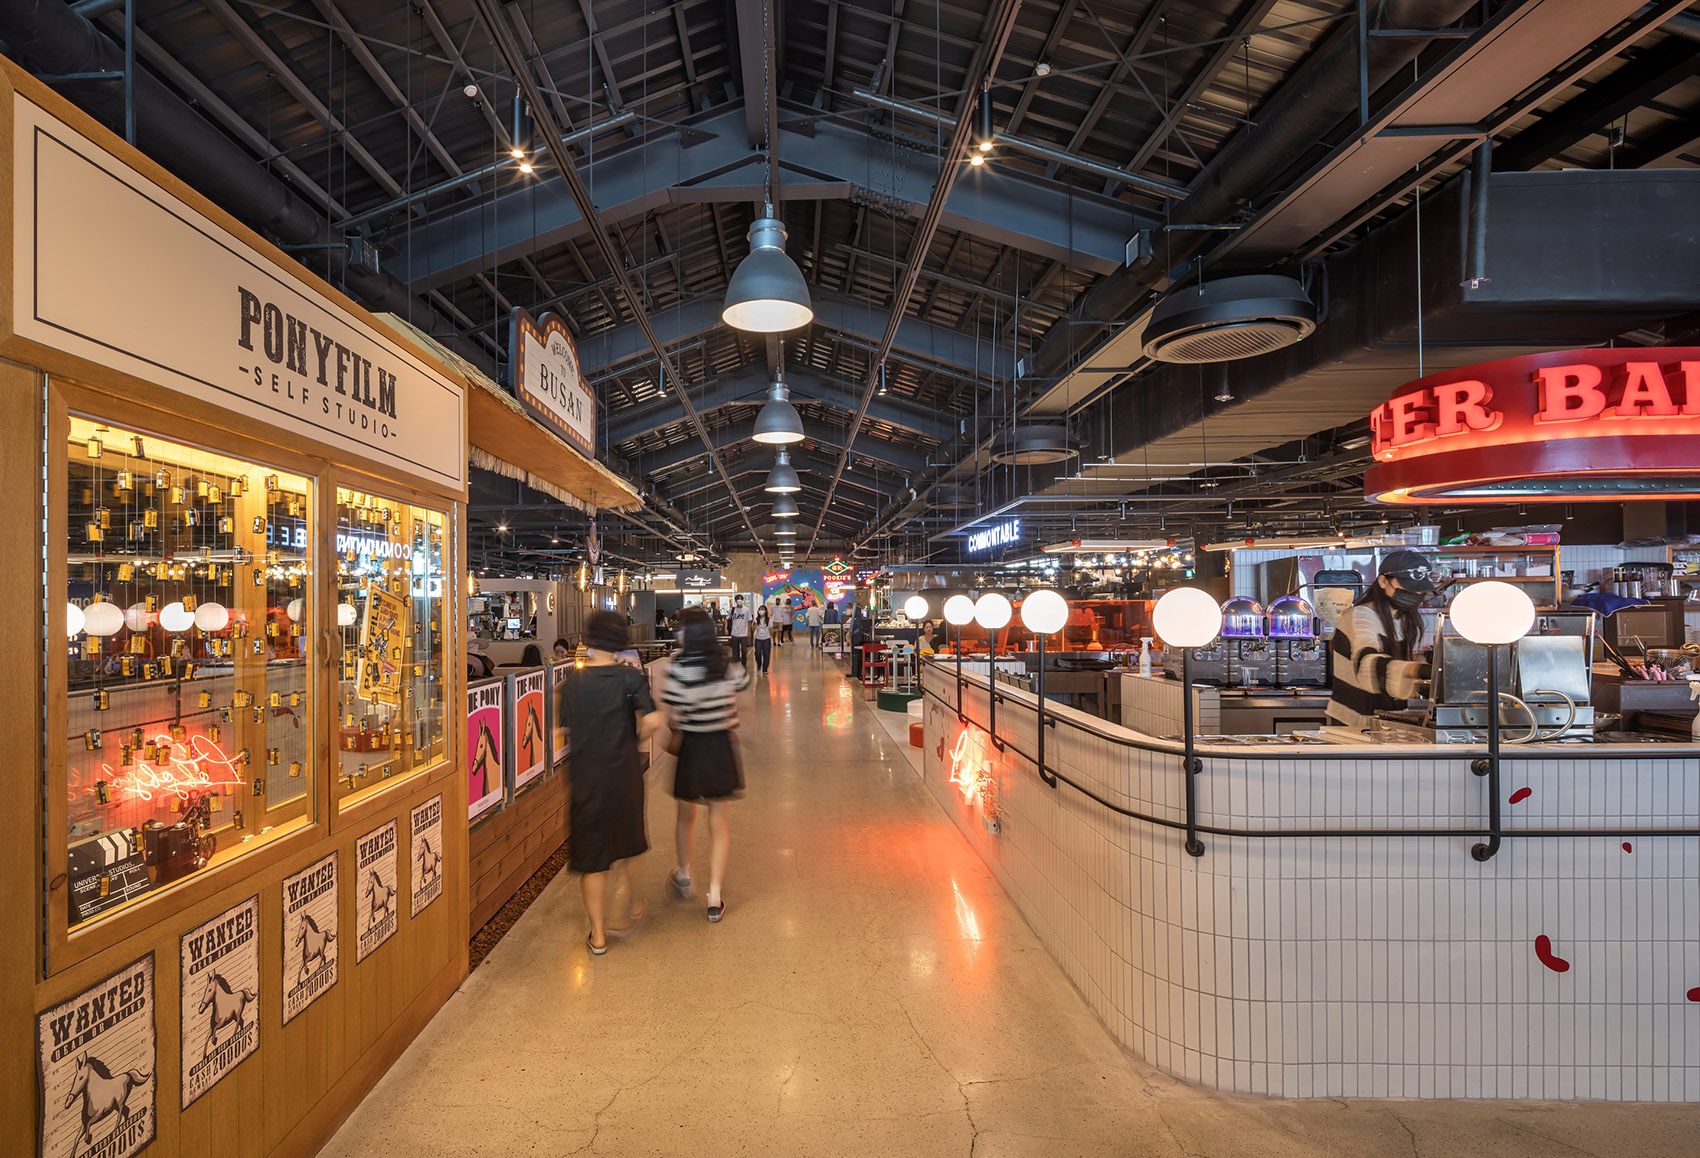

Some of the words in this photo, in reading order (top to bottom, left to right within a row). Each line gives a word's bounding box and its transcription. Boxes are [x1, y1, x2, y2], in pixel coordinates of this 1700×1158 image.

[238, 285, 397, 420] PONYFILM
[540, 363, 583, 423] BUSAN
[480, 685, 501, 707] PONY
[517, 678, 528, 699] THE
[528, 673, 543, 692] PONY
[414, 801, 440, 828] WANTED
[360, 826, 394, 860] WANTED
[288, 861, 333, 903] WANTED
[188, 907, 253, 963] WANTED
[49, 971, 145, 1047] WANTED
[55, 1036, 84, 1060] DEAD
[91, 1023, 105, 1038] OR
[112, 1000, 142, 1026] ALIVE
